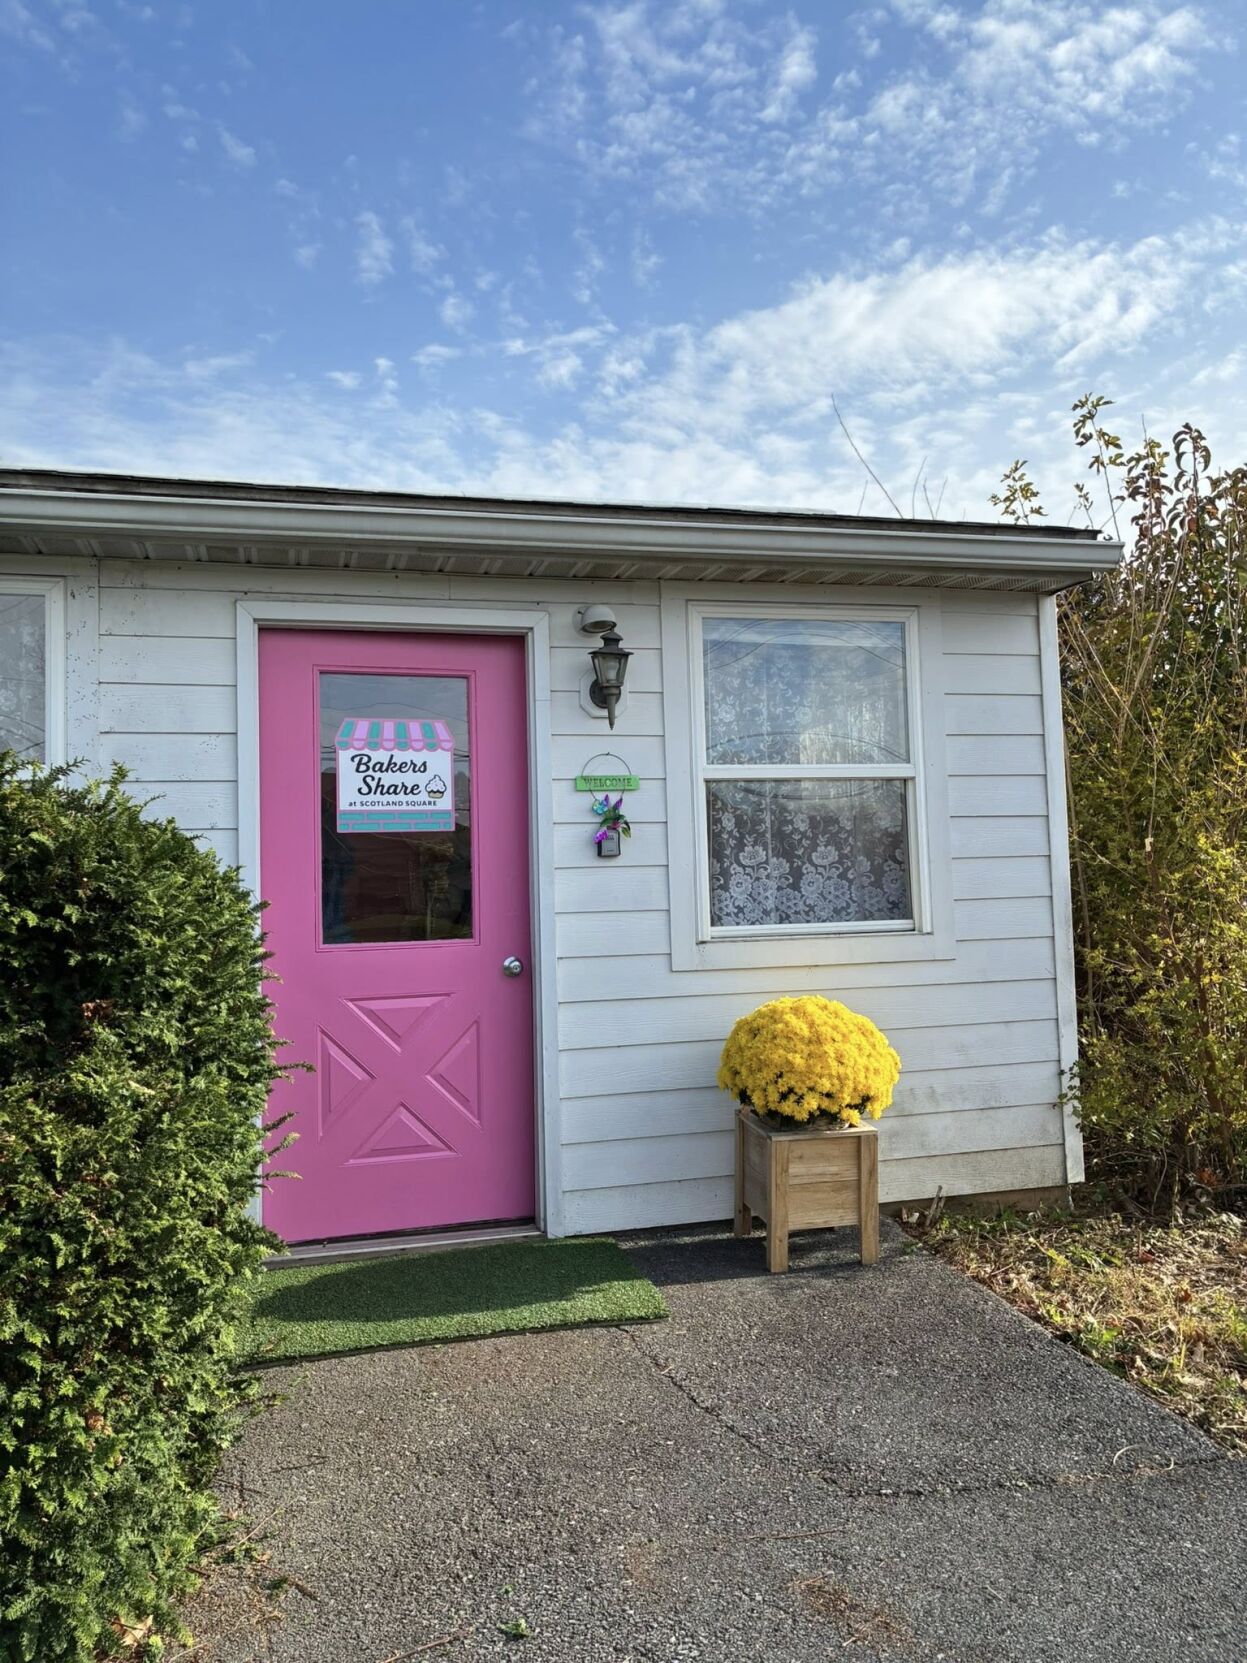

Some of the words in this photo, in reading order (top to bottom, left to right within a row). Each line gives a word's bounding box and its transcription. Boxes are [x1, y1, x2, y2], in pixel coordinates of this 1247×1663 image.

[350, 753, 427, 774] Bakers
[357, 774, 422, 796] Share
[583, 777, 633, 788] WELCOME
